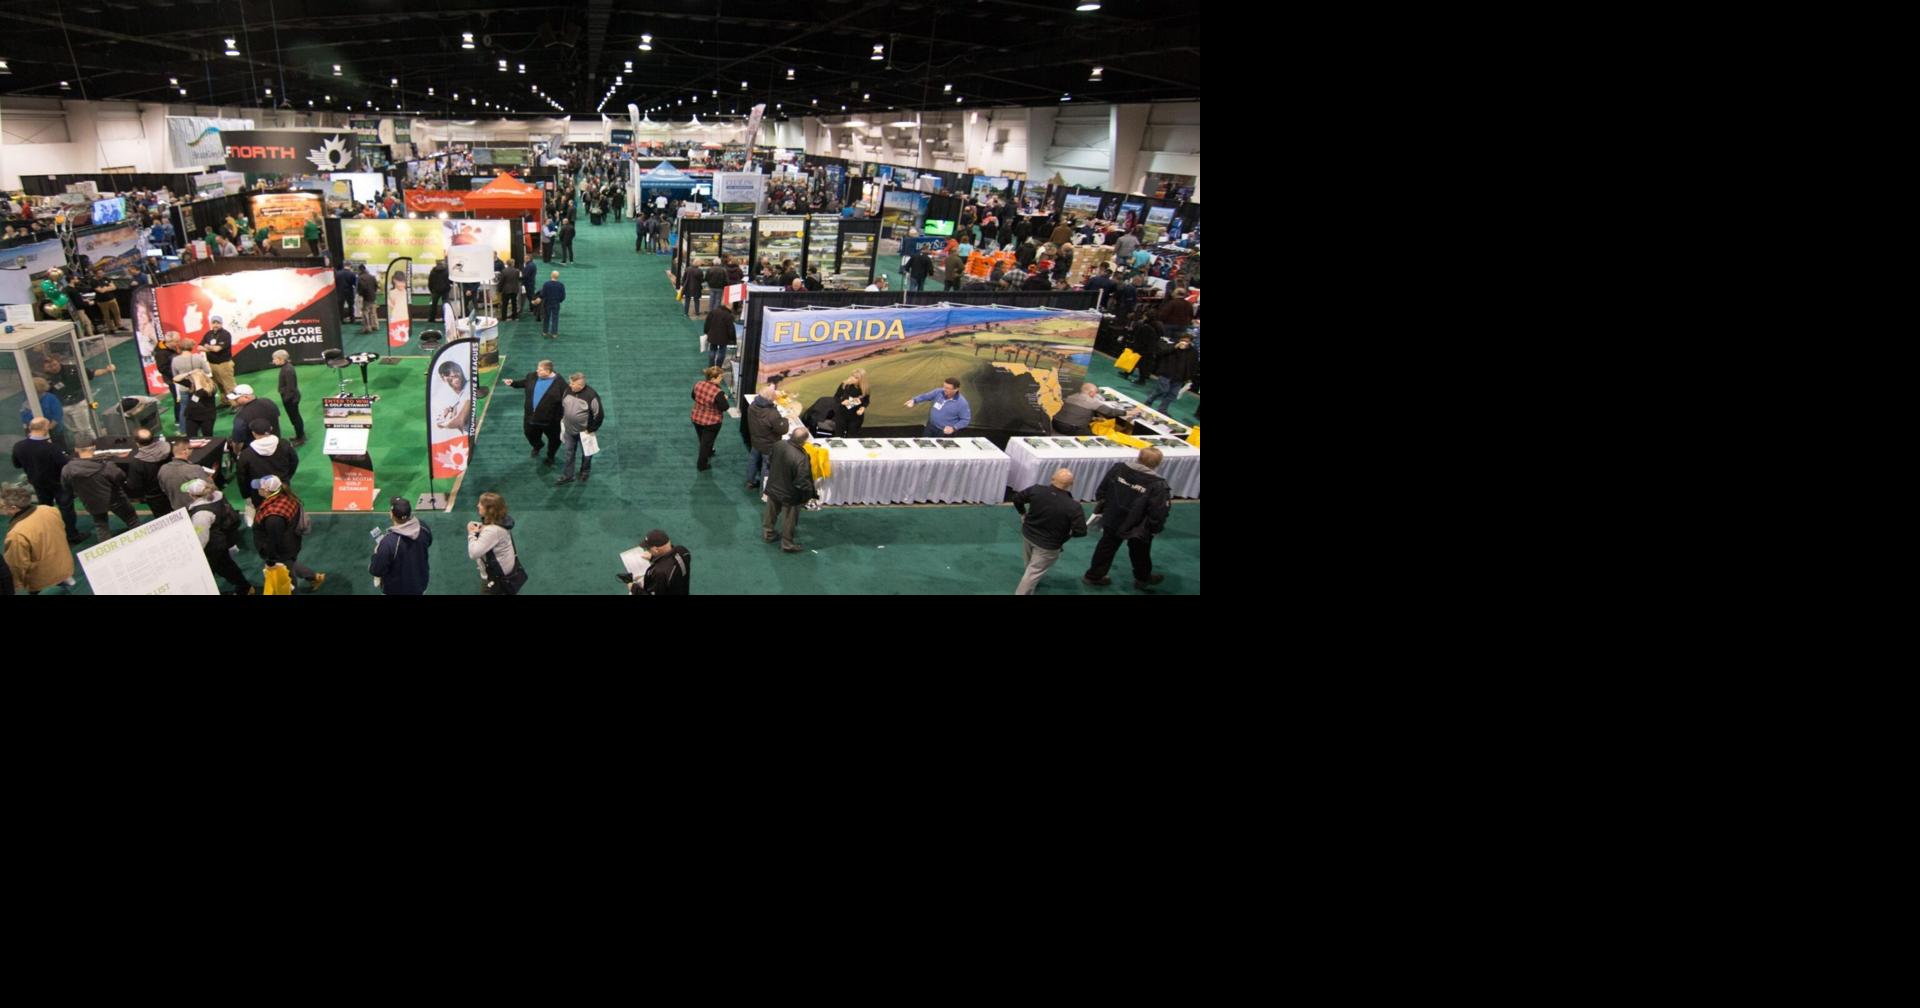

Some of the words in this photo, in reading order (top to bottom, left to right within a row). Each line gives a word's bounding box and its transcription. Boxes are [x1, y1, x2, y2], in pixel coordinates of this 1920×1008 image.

[267, 327, 323, 338] EXPLORE
[773, 319, 906, 343] FLORIDA
[251, 337, 287, 350] YOUR
[289, 335, 324, 344] GAME
[84, 541, 118, 561] FLOOR
[120, 528, 149, 545] PLAN
